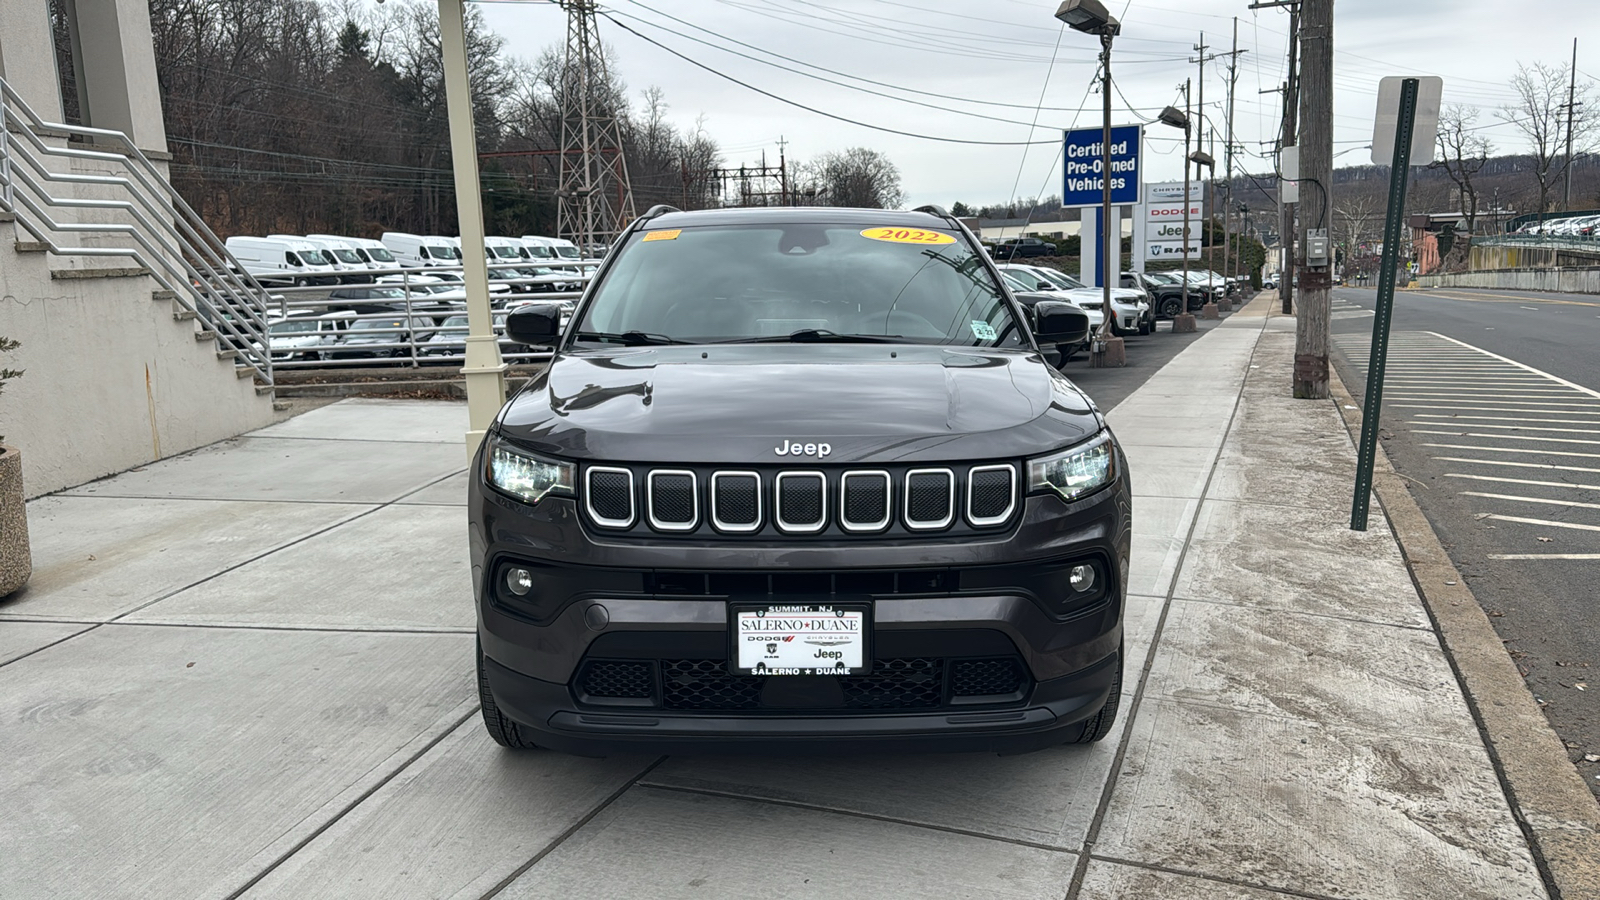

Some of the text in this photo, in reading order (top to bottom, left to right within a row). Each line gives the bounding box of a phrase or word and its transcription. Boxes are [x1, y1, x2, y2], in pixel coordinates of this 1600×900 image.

[1068, 141, 1127, 157] Certifed
[1067, 158, 1135, 174] Pre-Oned
[1068, 177, 1125, 191] Vehices
[878, 229, 940, 242] 2022
[1157, 224, 1192, 238] Jeep
[1163, 246, 1198, 254] RAM
[774, 439, 832, 458] Jeep
[741, 619, 859, 631] SALERNO DUANE
[813, 648, 843, 660] Jeep
[751, 667, 851, 676] SALERNO DUANE
